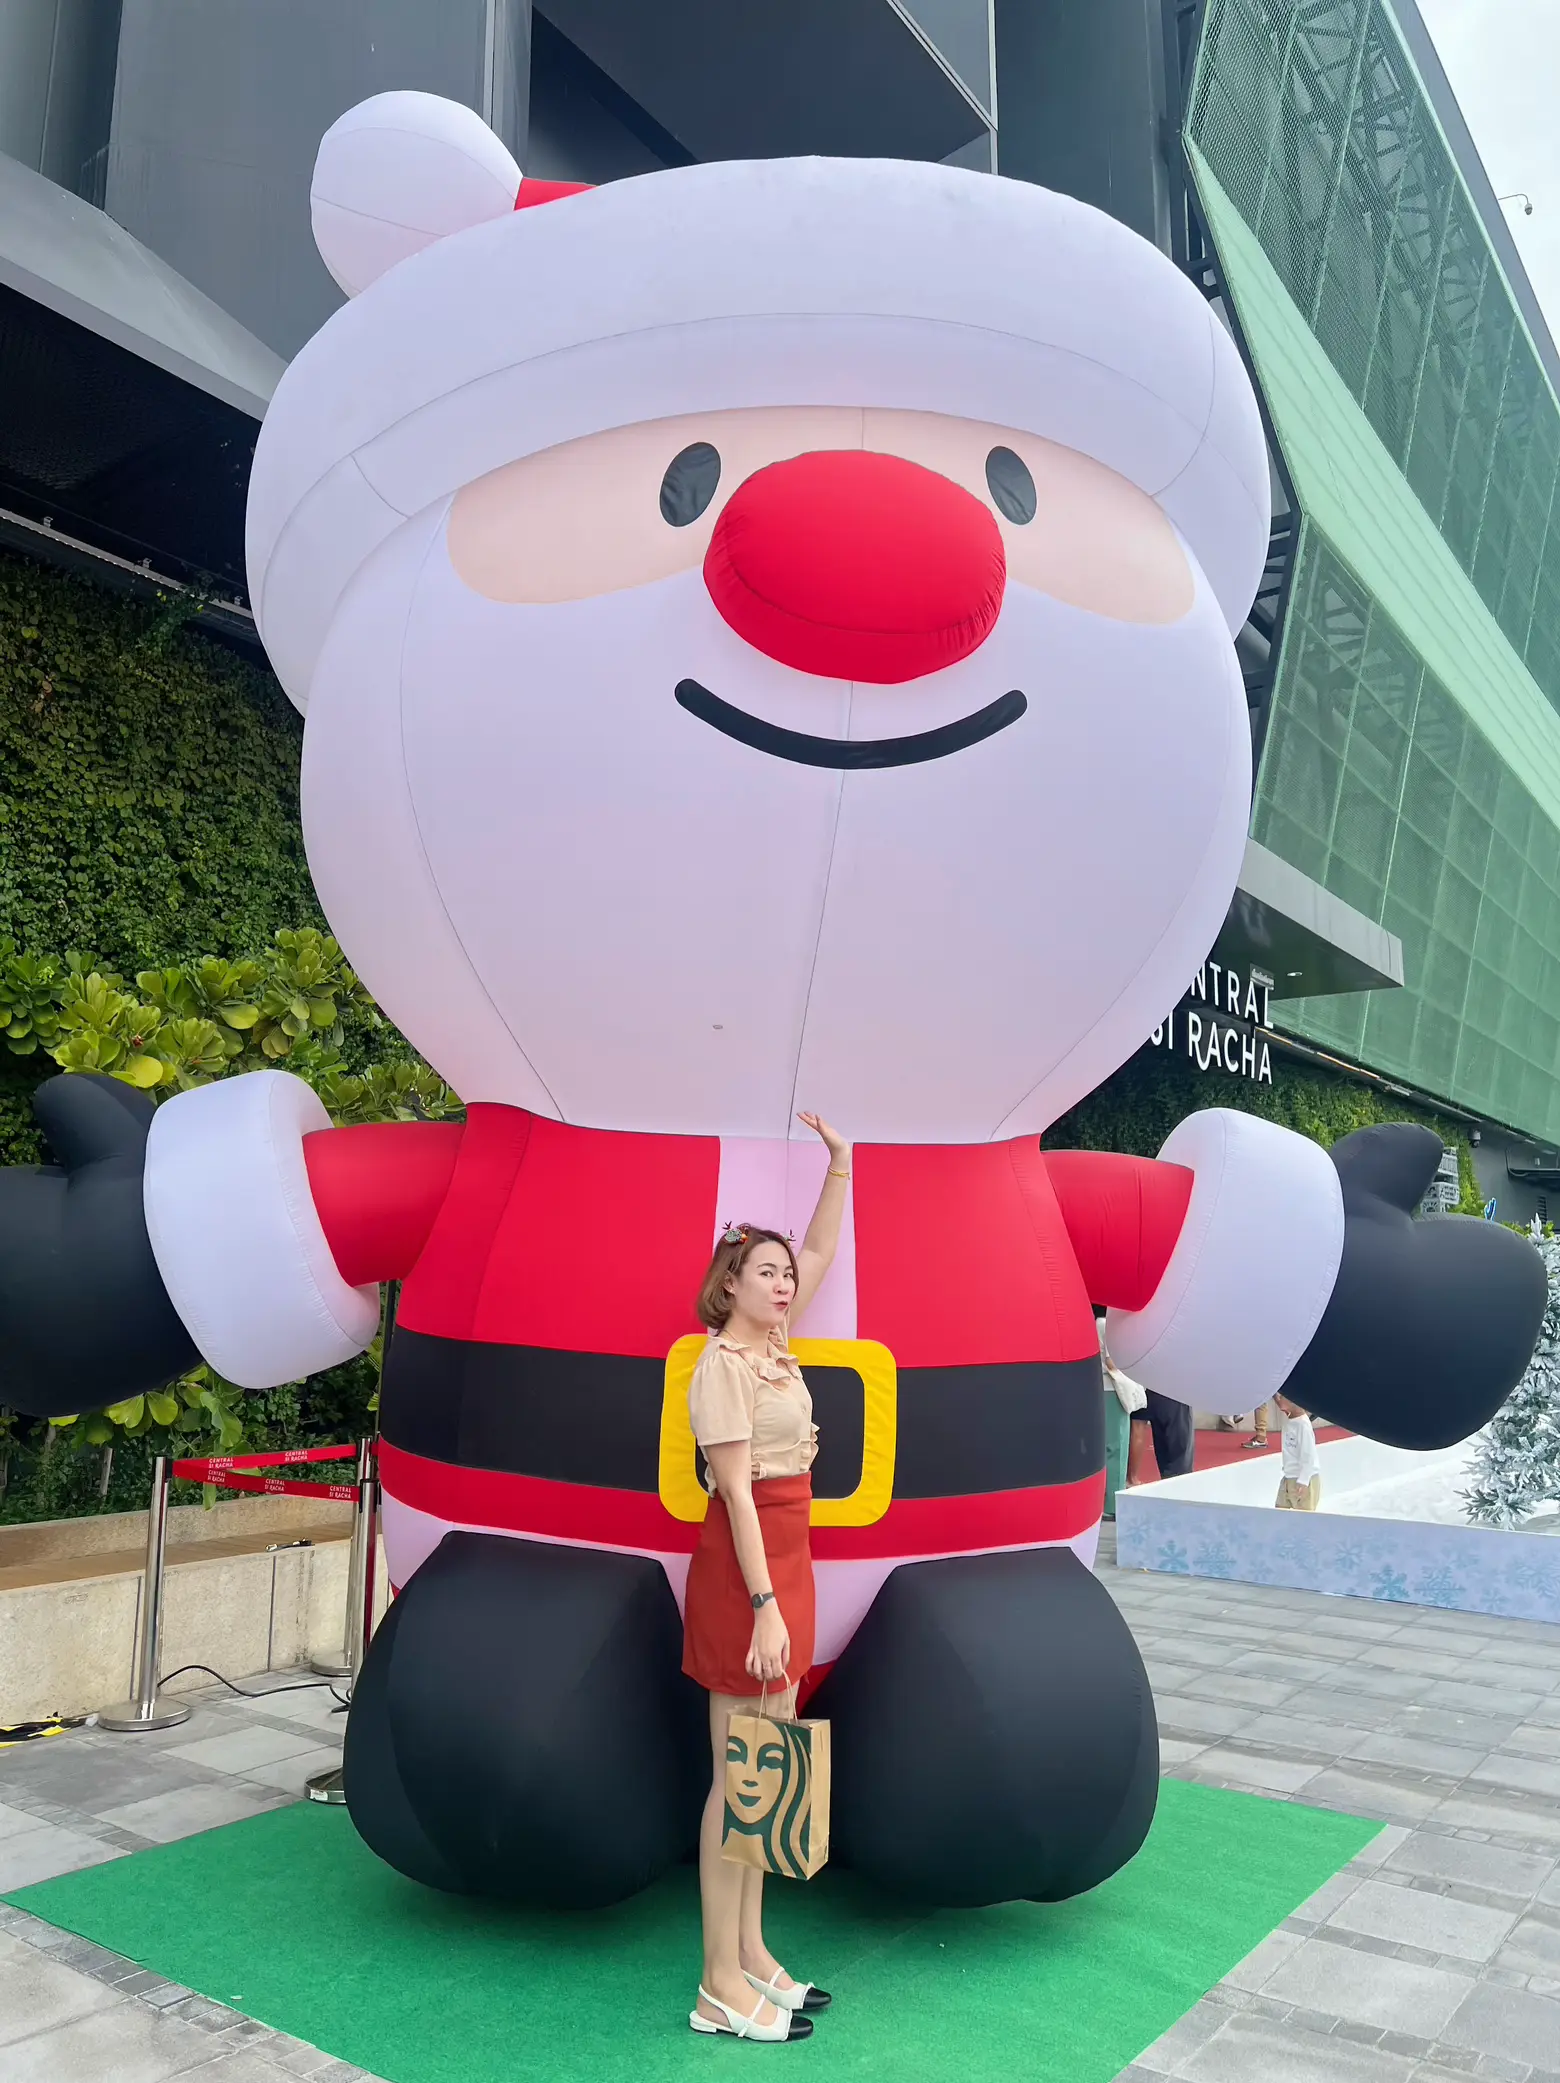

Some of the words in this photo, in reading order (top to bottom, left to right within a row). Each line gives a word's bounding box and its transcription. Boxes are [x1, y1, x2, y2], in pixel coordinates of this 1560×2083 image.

[1188, 1011, 1273, 1085] RACHA
[208, 1469, 226, 1478] CENTRAL
[265, 1478, 285, 1486] CENTRAL
[329, 1485, 352, 1493] CENTRAL
[335, 1491, 352, 1499] RACHA
